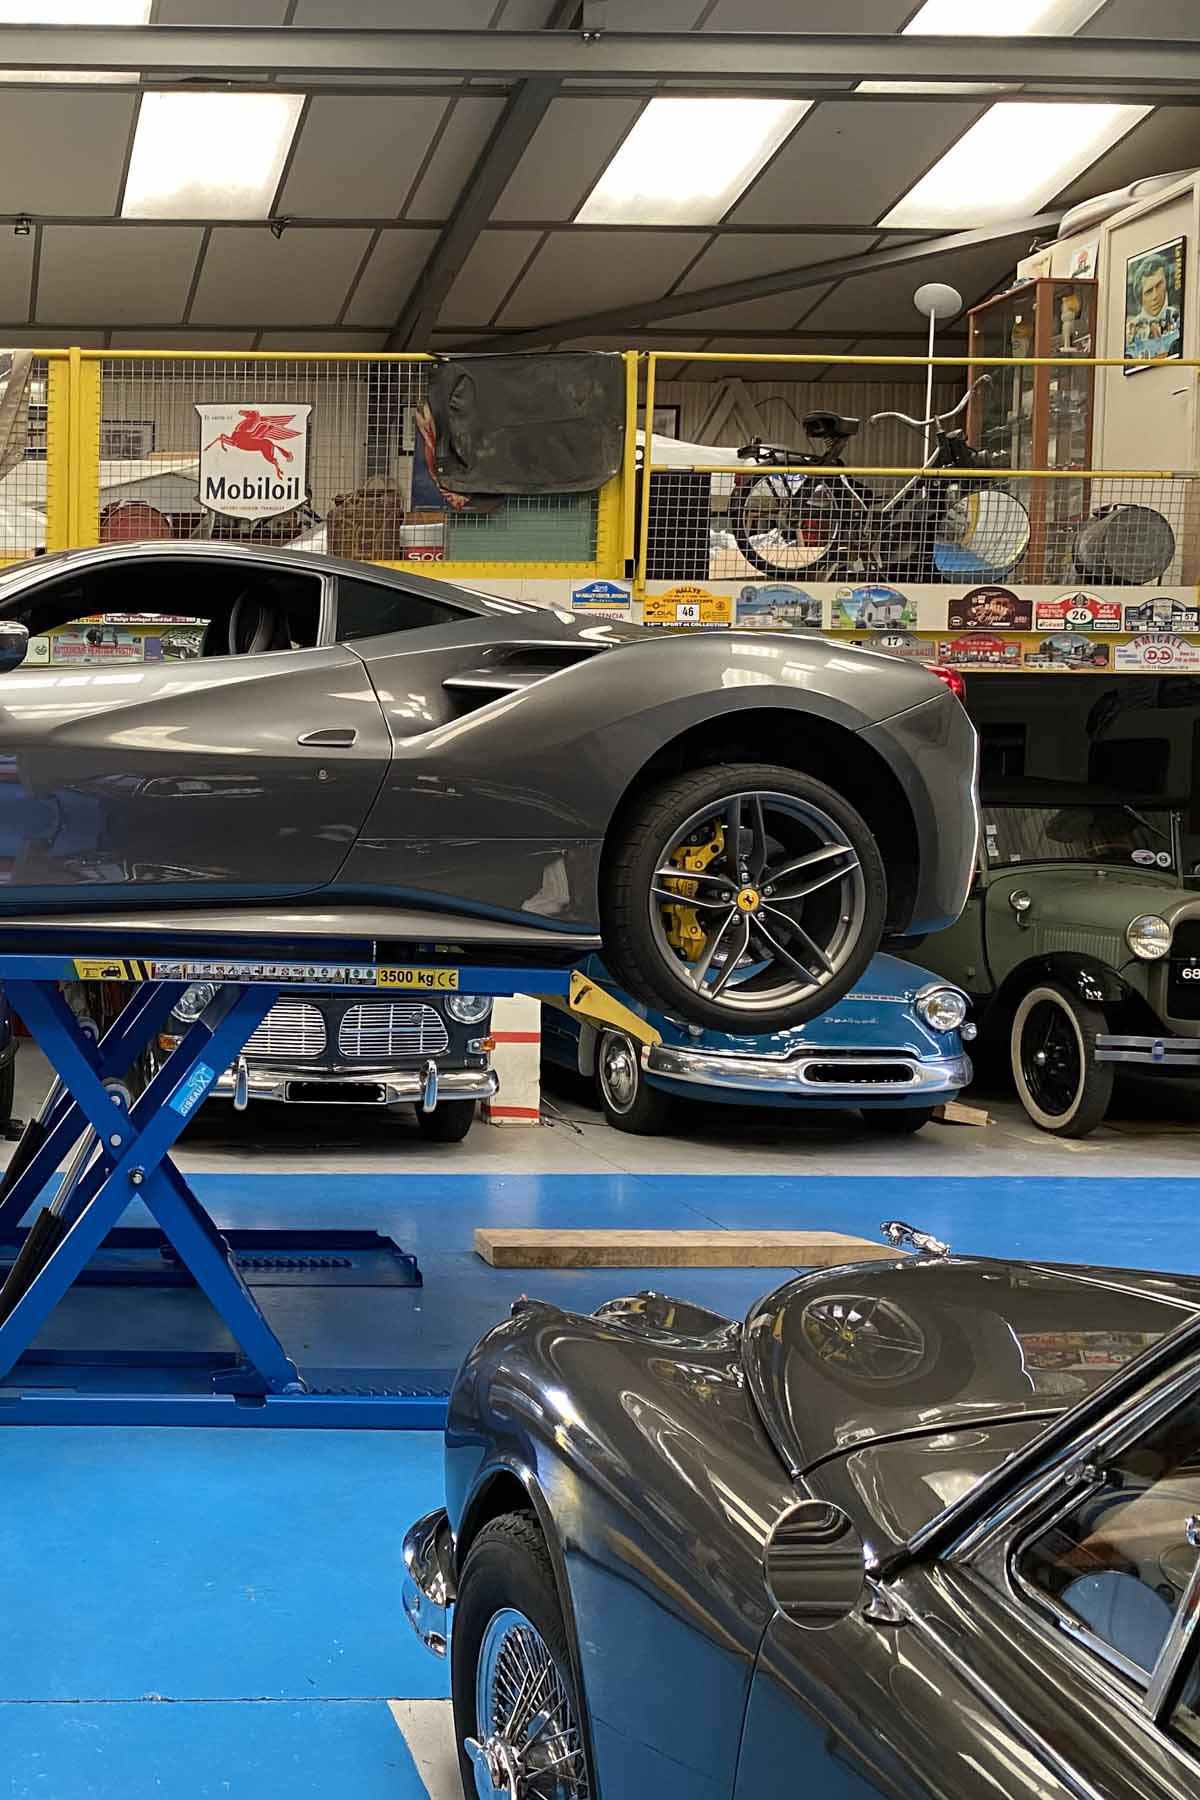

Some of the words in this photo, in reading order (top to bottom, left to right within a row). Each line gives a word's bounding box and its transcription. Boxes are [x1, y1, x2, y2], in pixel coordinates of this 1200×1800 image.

[206, 476, 300, 500] Mobiloil
[682, 607, 694, 617] 46
[1072, 610, 1087, 620] 26
[1184, 613, 1195, 621] 57
[886, 637, 899, 646] 17
[1134, 634, 1185, 649] AMICALE
[380, 969, 413, 983] 3500
[417, 971, 434, 987] kg
